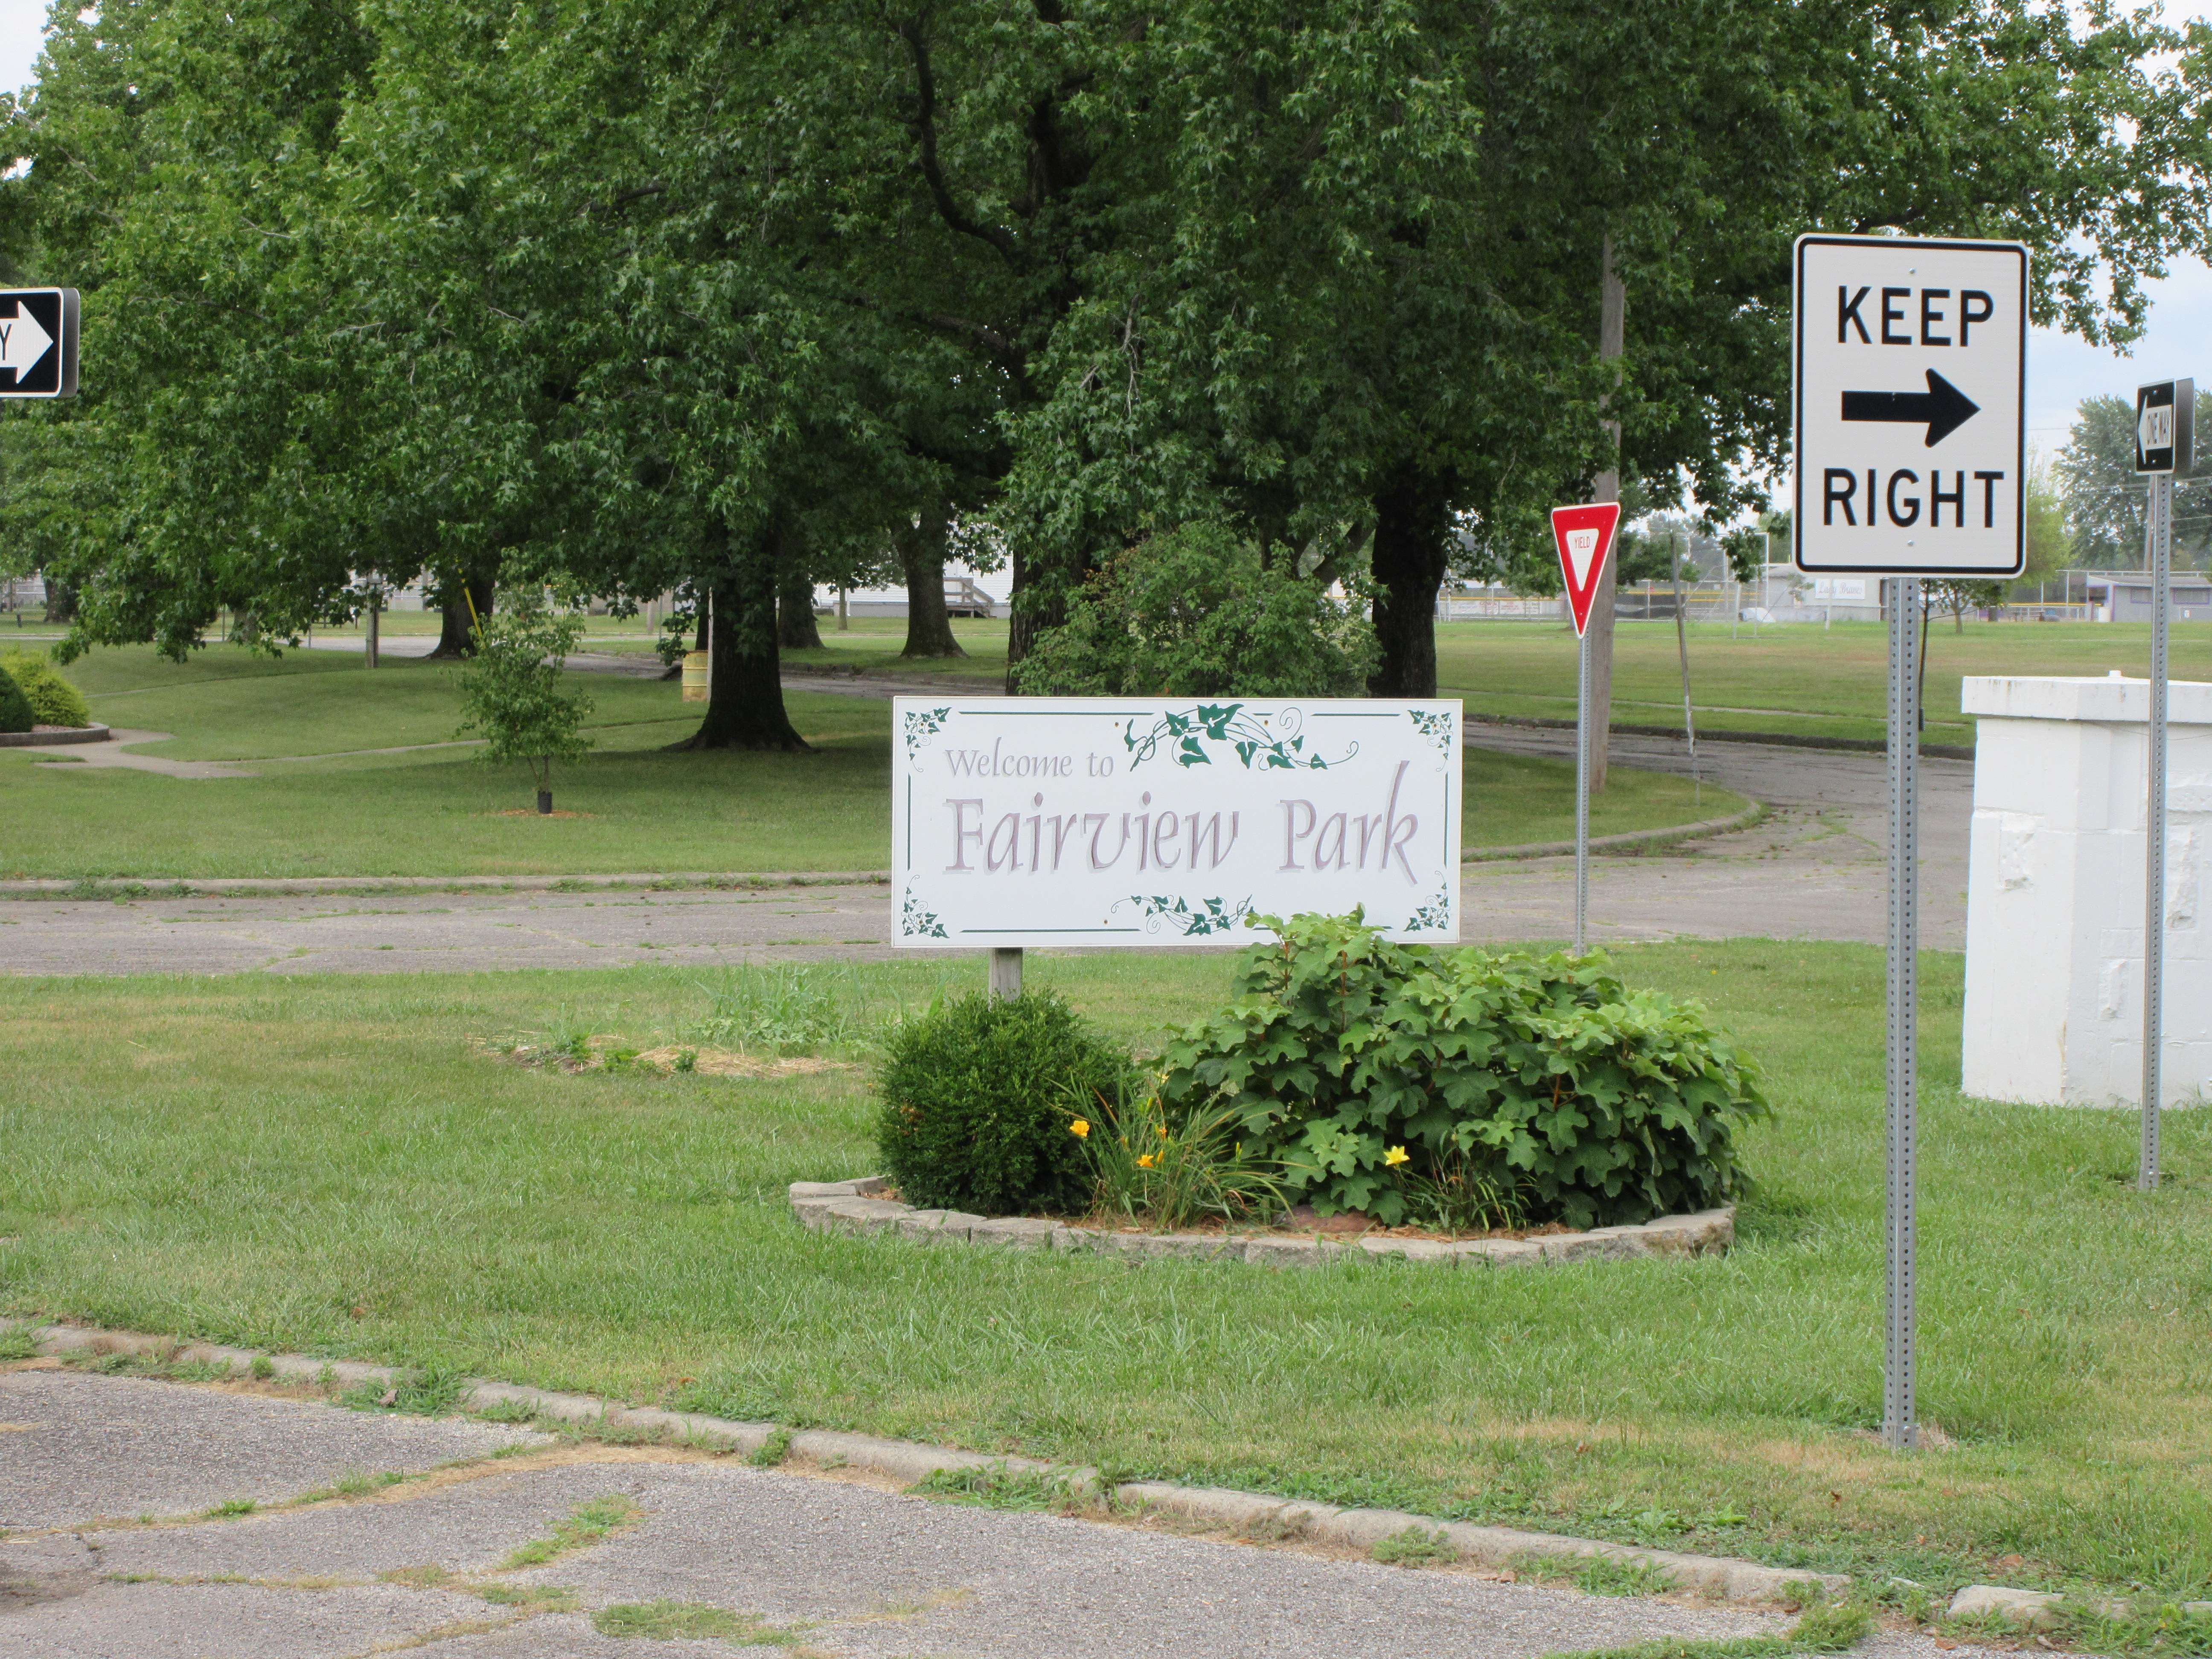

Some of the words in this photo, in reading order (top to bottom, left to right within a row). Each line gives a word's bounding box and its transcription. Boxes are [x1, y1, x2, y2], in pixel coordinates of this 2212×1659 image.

[1838, 285, 1994, 347] KEEP
[1823, 468, 2005, 528] RIGHT
[1574, 536, 1590, 549] YIELD
[944, 736, 1073, 777] Welcome
[1086, 752, 1114, 777] to
[944, 791, 1240, 872] Fairview
[1278, 760, 1419, 885] Park
